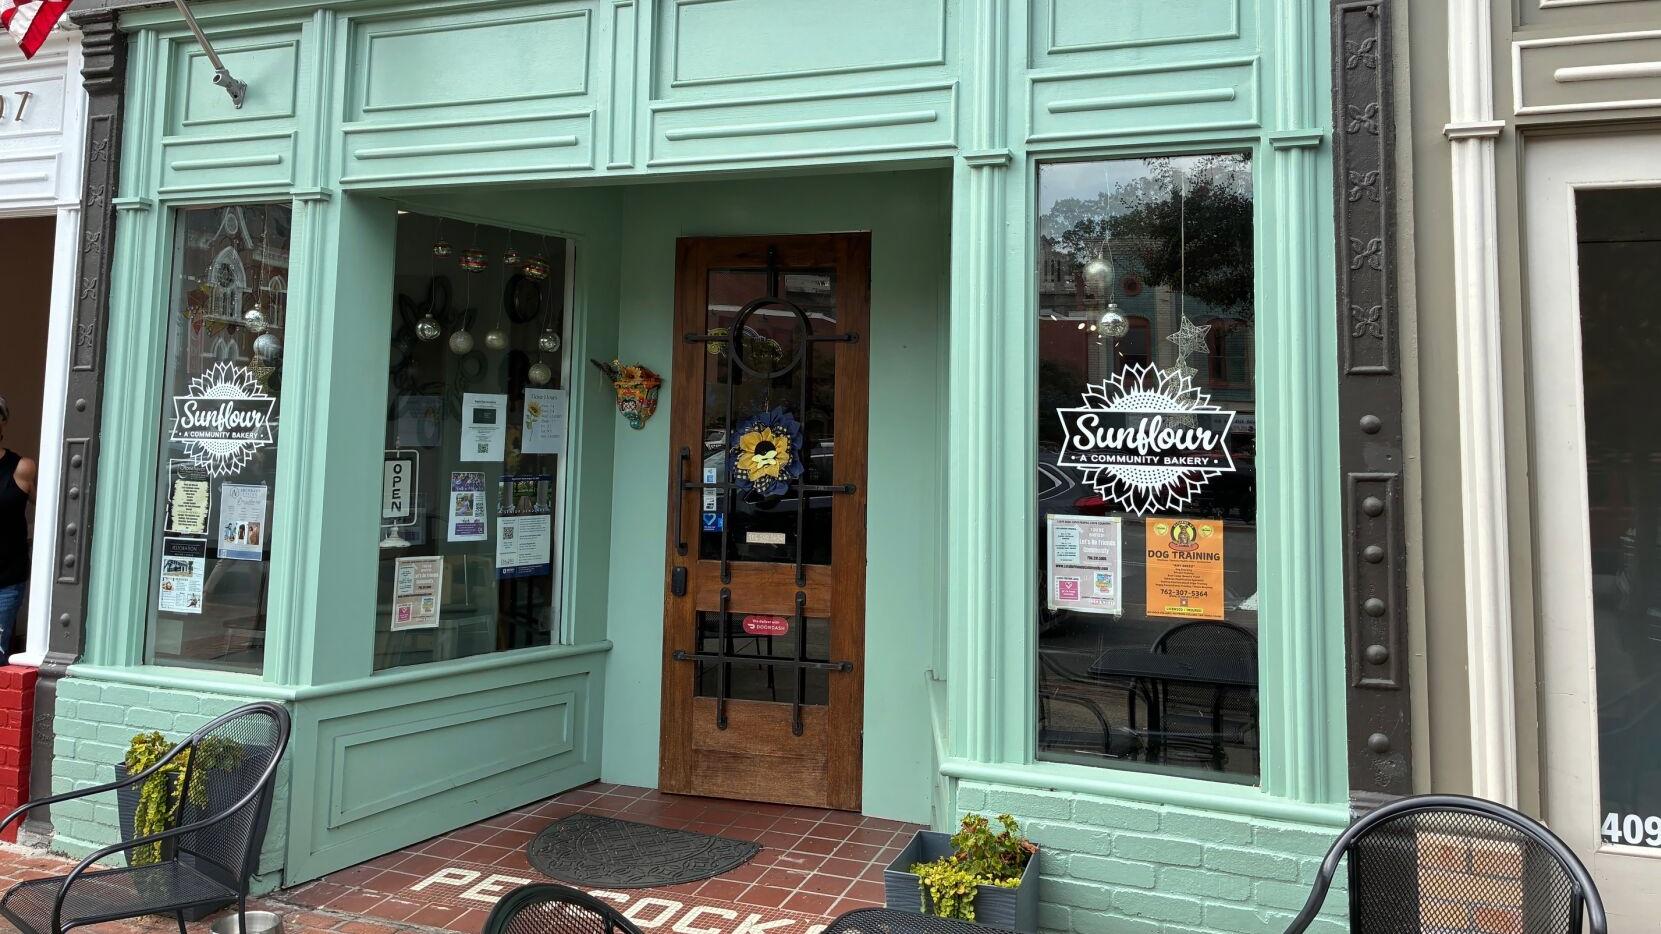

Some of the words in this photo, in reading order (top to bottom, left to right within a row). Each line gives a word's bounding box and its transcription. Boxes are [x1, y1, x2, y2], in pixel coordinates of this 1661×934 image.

[0, 91, 33, 121] 7
[181, 401, 265, 431] Sunflour
[1073, 413, 1218, 455] Sunflour
[1091, 455, 1159, 464] COMMUNITY
[1164, 456, 1209, 465] BAKERY
[391, 463, 402, 512] OPEN
[1148, 550, 1169, 559] DOG
[1172, 551, 1220, 560] TRAINING
[1161, 589, 1208, 597] 762-307-5364
[1601, 812, 1661, 846] 409
